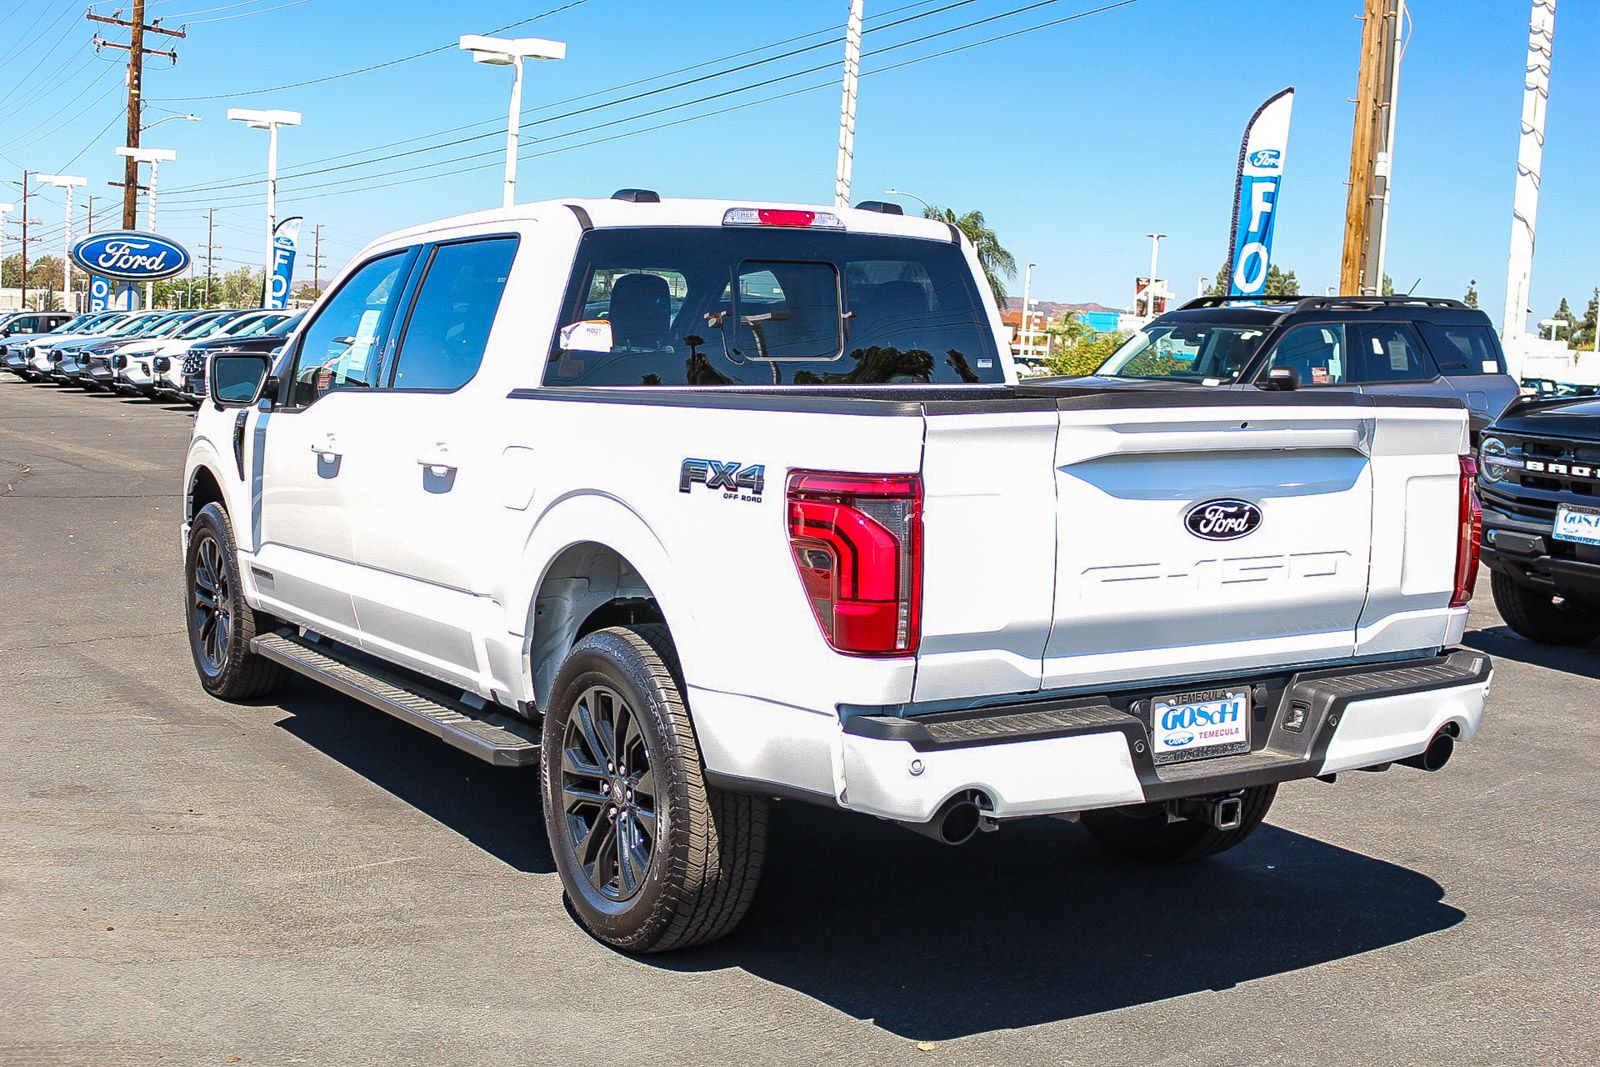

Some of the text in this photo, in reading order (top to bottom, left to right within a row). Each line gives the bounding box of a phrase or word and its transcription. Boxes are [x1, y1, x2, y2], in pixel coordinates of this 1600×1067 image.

[1234, 181, 1276, 294] FO
[98, 241, 167, 271] Ford
[679, 457, 766, 495] FX4
[1525, 460, 1600, 479] BRO
[723, 492, 763, 503] OFF ROAD
[1198, 504, 1252, 534] Ford
[1174, 689, 1228, 704] TEMECULA
[1198, 727, 1240, 740] TEMECULA
